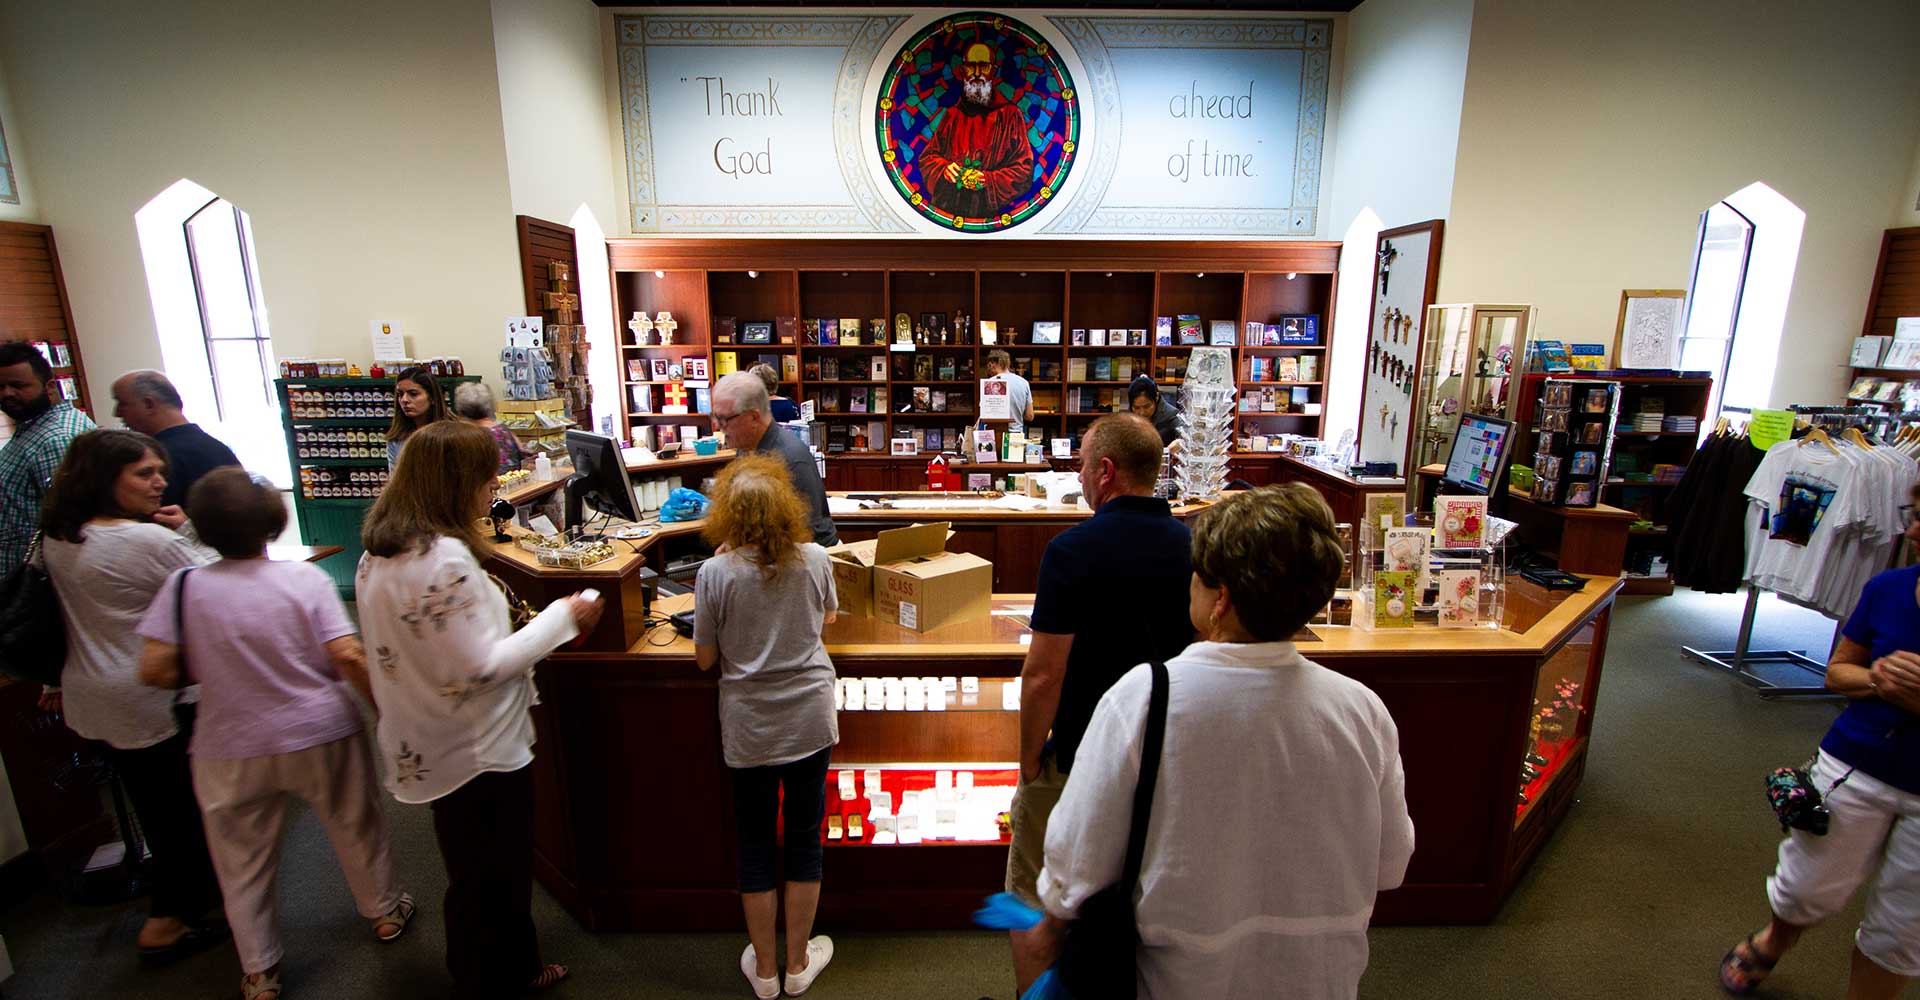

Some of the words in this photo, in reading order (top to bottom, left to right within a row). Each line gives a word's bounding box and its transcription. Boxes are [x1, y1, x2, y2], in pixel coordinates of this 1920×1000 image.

[1169, 79, 1255, 119] ahead
[714, 137, 772, 180] God
[1167, 139, 1195, 183] of
[888, 577, 913, 596] GLASS
